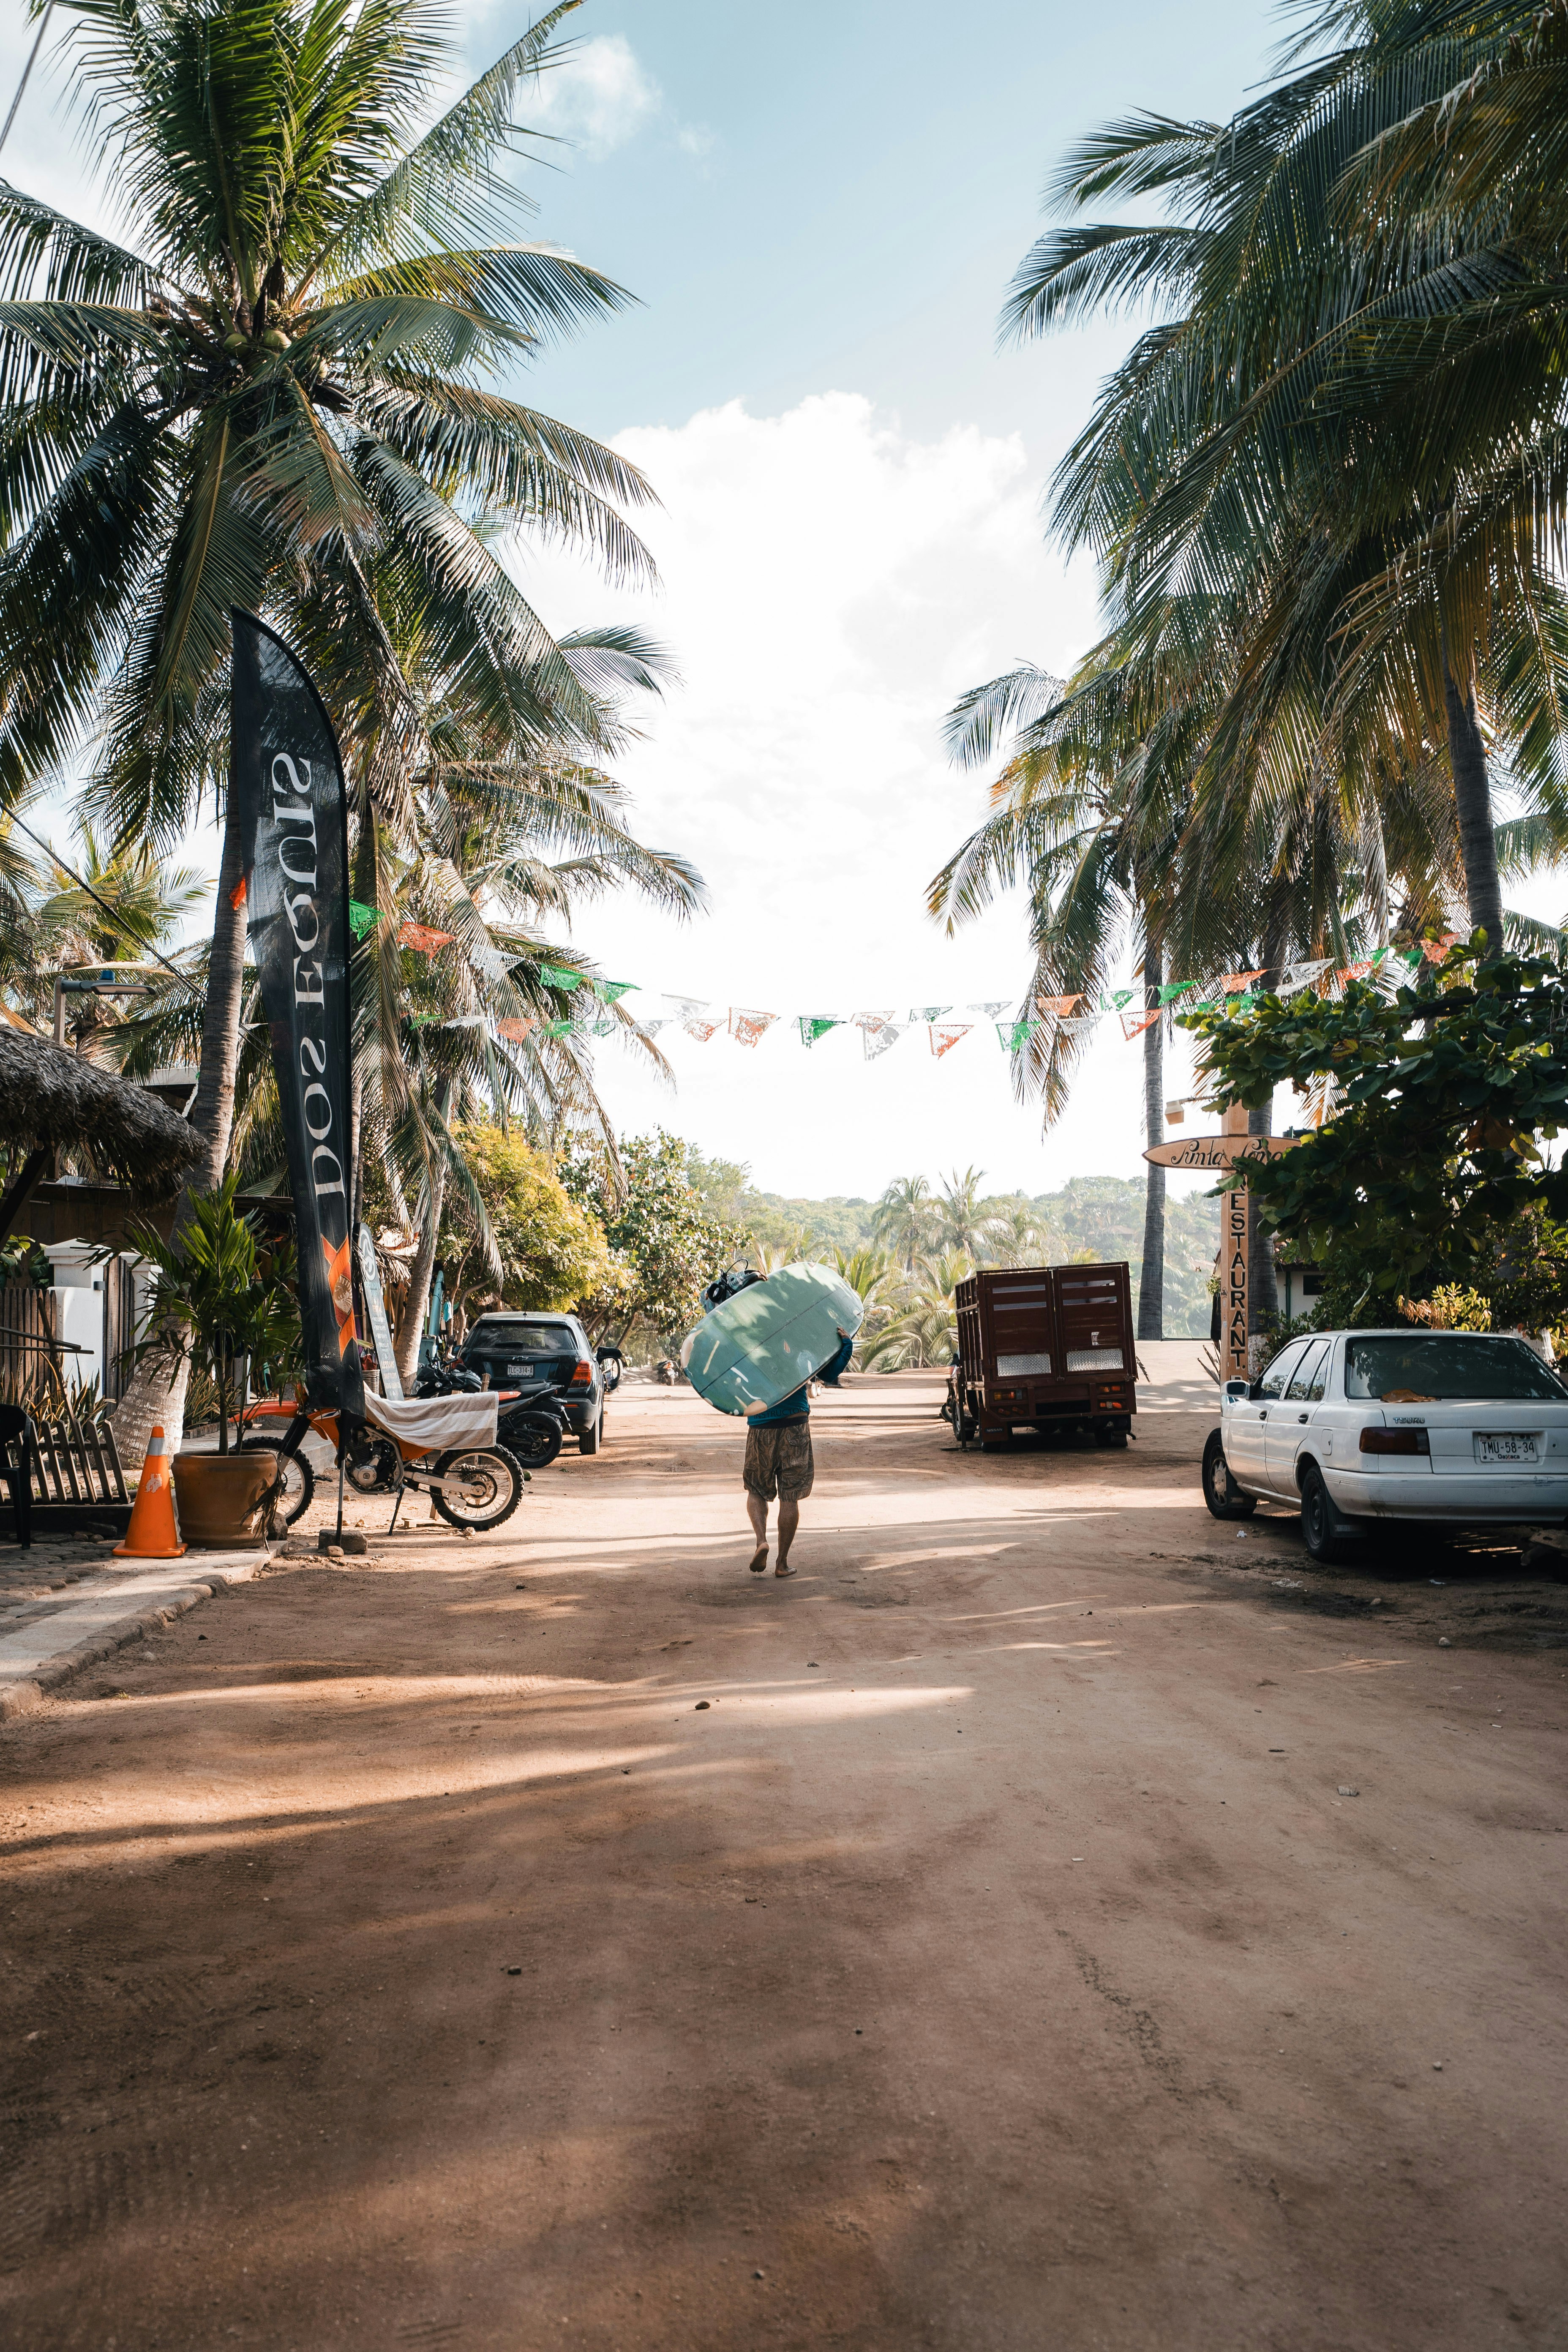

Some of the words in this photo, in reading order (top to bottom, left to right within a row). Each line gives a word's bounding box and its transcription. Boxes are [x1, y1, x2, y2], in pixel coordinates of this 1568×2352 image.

[1230, 1181, 1246, 1369] ESTAURANT.
[381, 1360, 395, 1368] LESSONS
[1481, 1442, 1534, 1454] TMU-58-34
